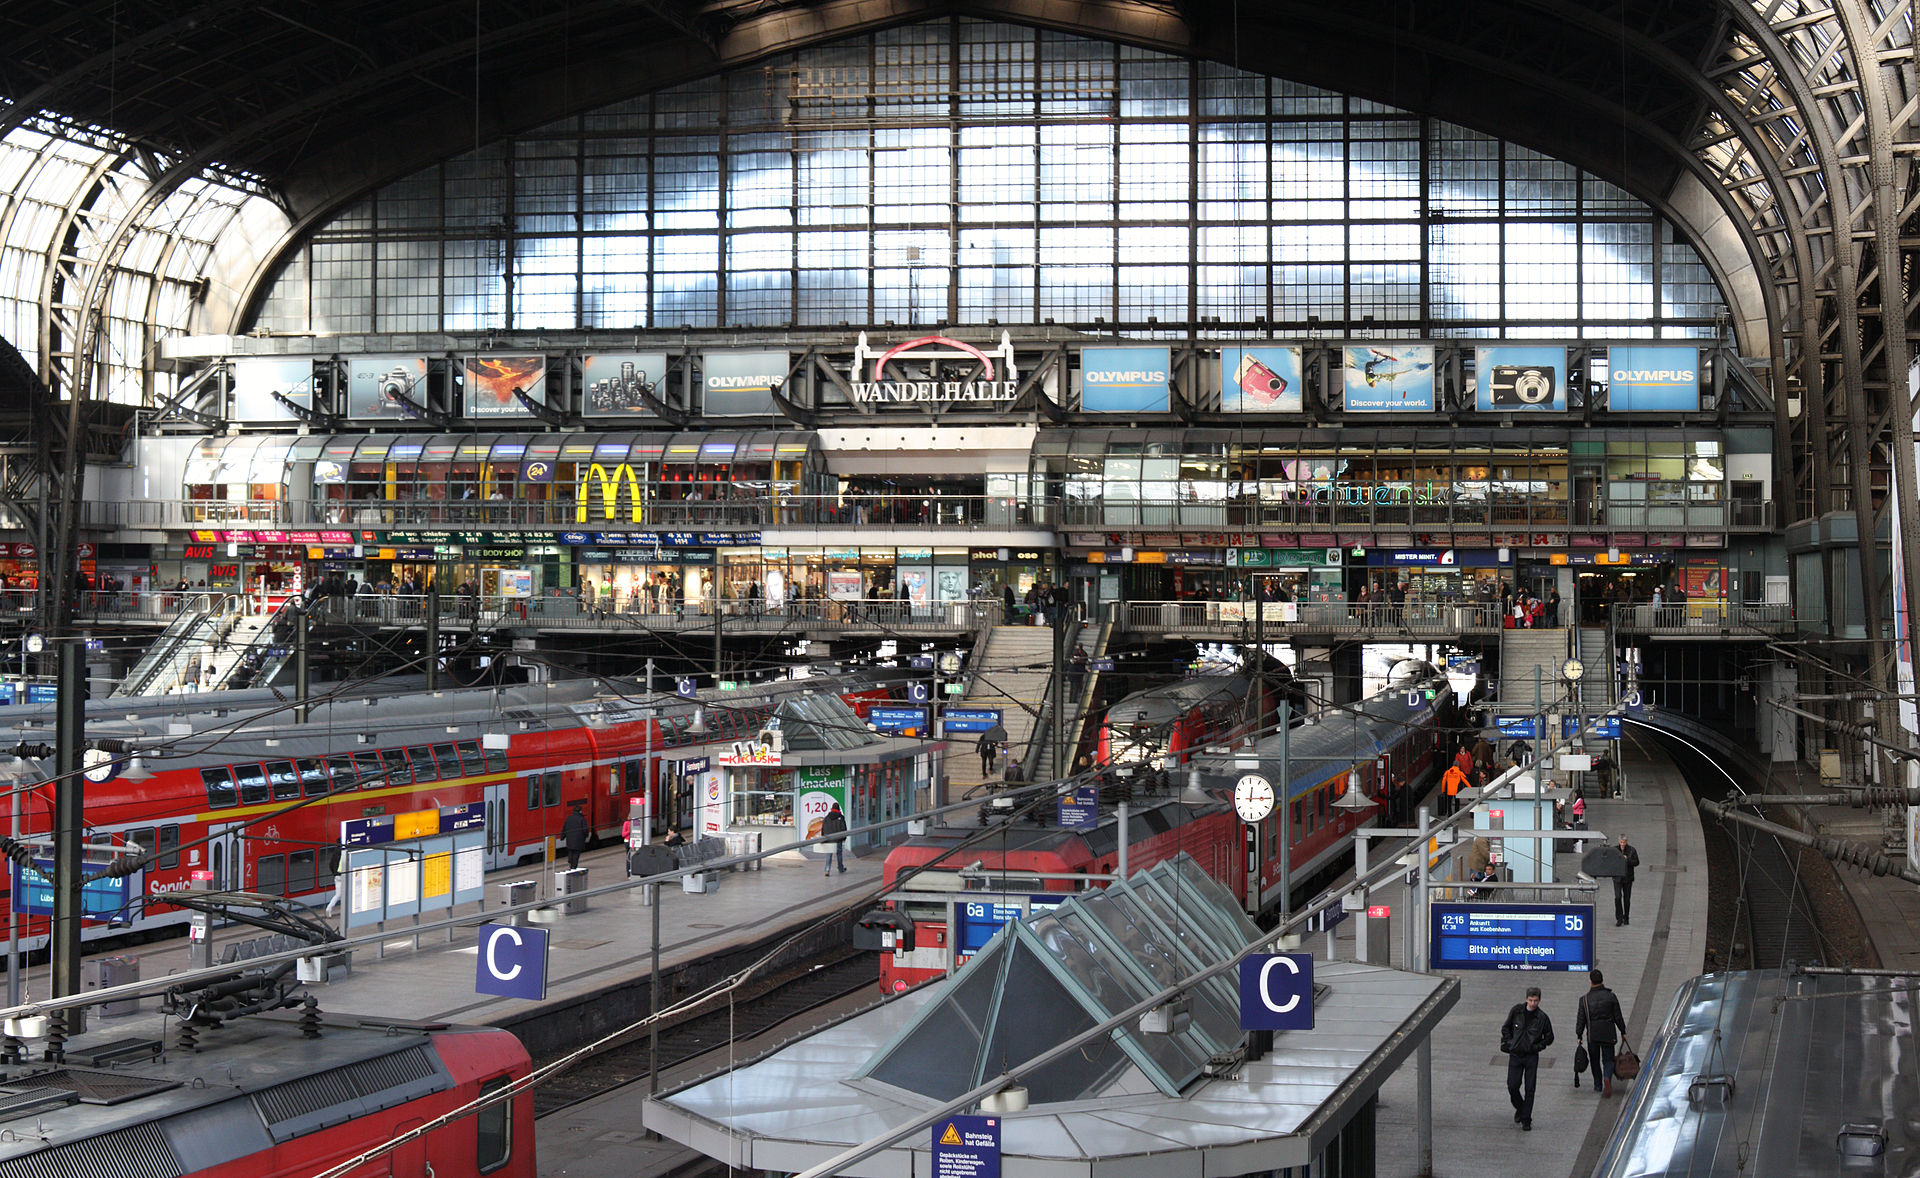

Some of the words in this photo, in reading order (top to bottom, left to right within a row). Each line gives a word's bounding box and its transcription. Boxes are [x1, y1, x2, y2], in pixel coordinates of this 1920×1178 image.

[1086, 371, 1164, 383] OLYMPUS
[1614, 370, 1694, 382] OLYMPUS
[851, 381, 1017, 402] WANDELHALLE
[530, 467, 543, 476] 24
[184, 546, 214, 558] AVIS
[899, 549, 932, 560] Douglas
[972, 552, 998, 560] phot
[209, 565, 238, 576] AVIS
[680, 679, 691, 696] C
[914, 684, 926, 700] C
[1488, 682, 1494, 690] E
[1408, 692, 1420, 706] D
[809, 767, 831, 776] Lass
[800, 777, 844, 788] knacken!
[804, 802, 828, 814] 1,20
[246, 864, 251, 877] 2
[150, 880, 192, 894] Servic
[40, 894, 55, 902] Lübe
[966, 902, 984, 917] 6a
[1442, 916, 1464, 924] 12:16
[1564, 915, 1583, 931] 5b
[486, 928, 523, 982] C
[1469, 946, 1488, 954] Bitte
[1491, 946, 1511, 954] nicht
[1514, 947, 1554, 956] einsteigen
[1258, 956, 1301, 1014] C
[965, 1132, 992, 1140] Bahnsteig
